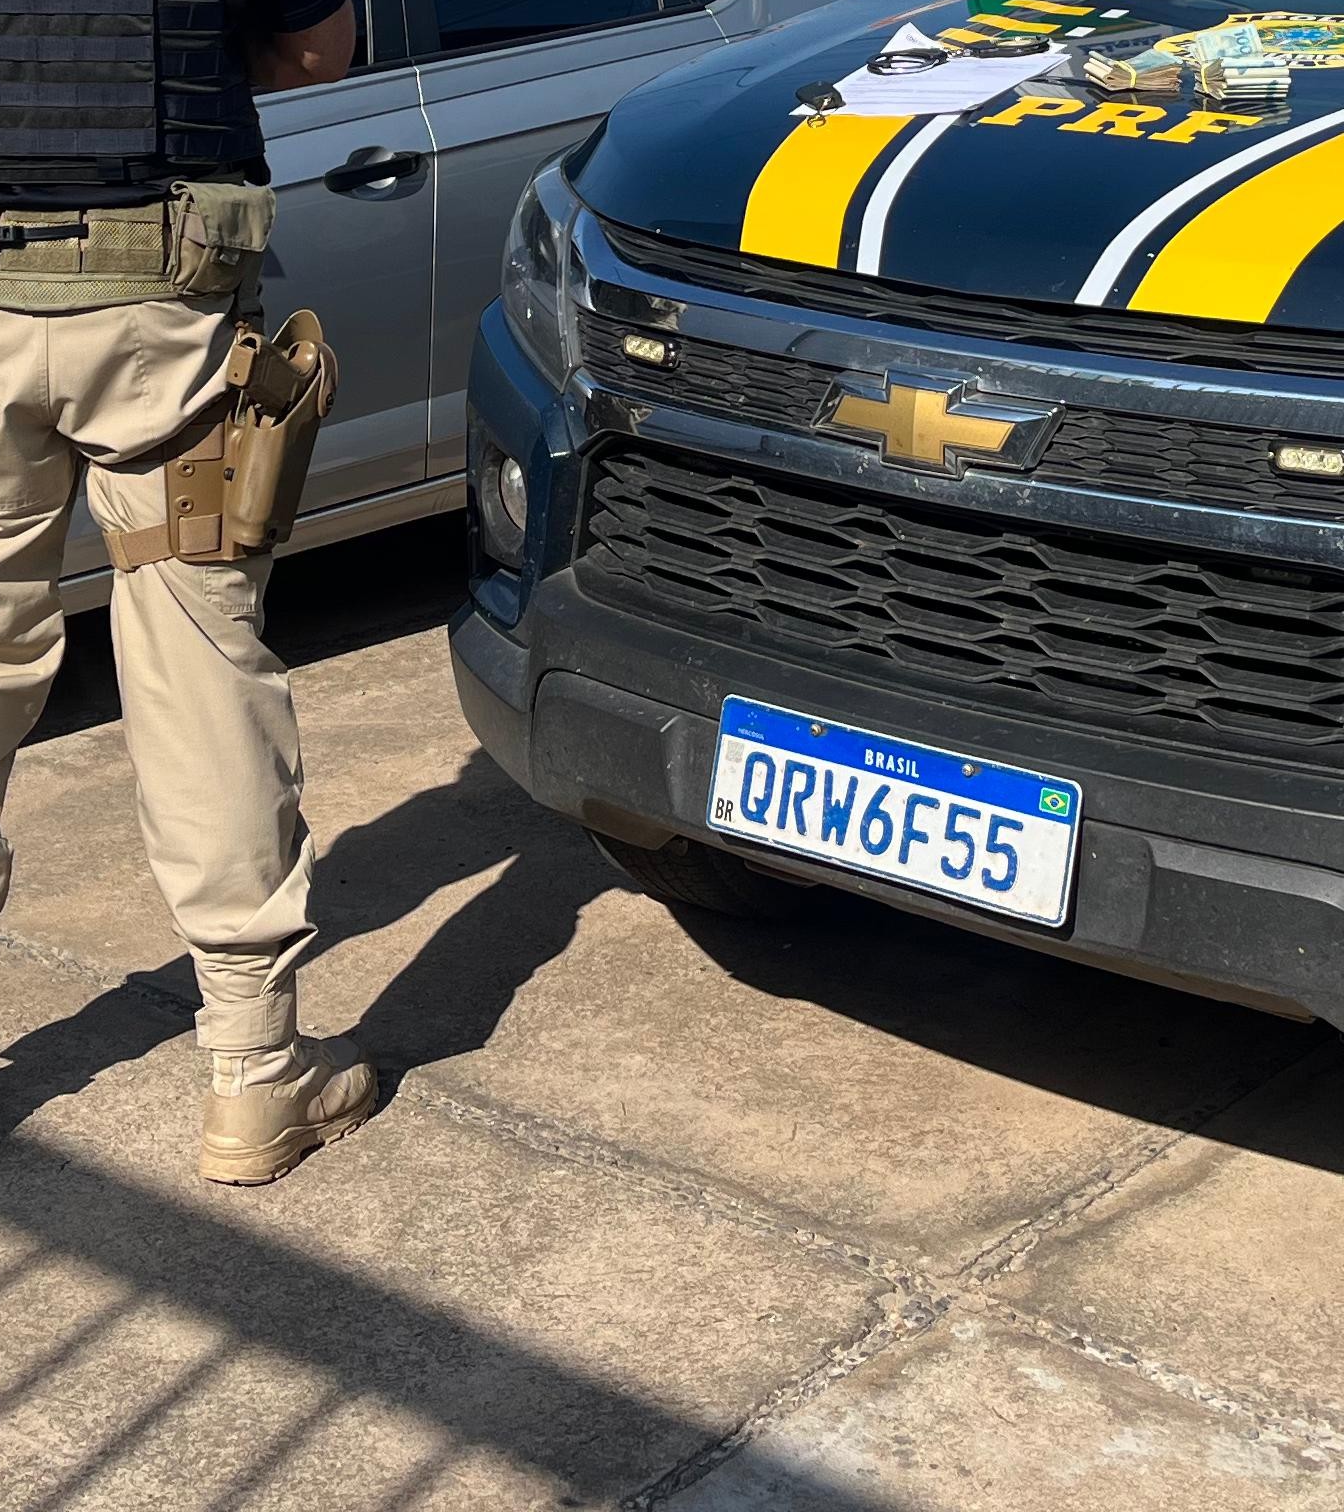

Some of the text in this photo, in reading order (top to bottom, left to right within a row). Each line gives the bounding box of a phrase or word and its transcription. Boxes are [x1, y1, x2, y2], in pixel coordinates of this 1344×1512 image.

[977, 95, 1264, 144] PRF
[864, 749, 920, 779] BRASIL
[714, 796, 734, 822] BR
[739, 751, 1025, 893] QRW6F55
